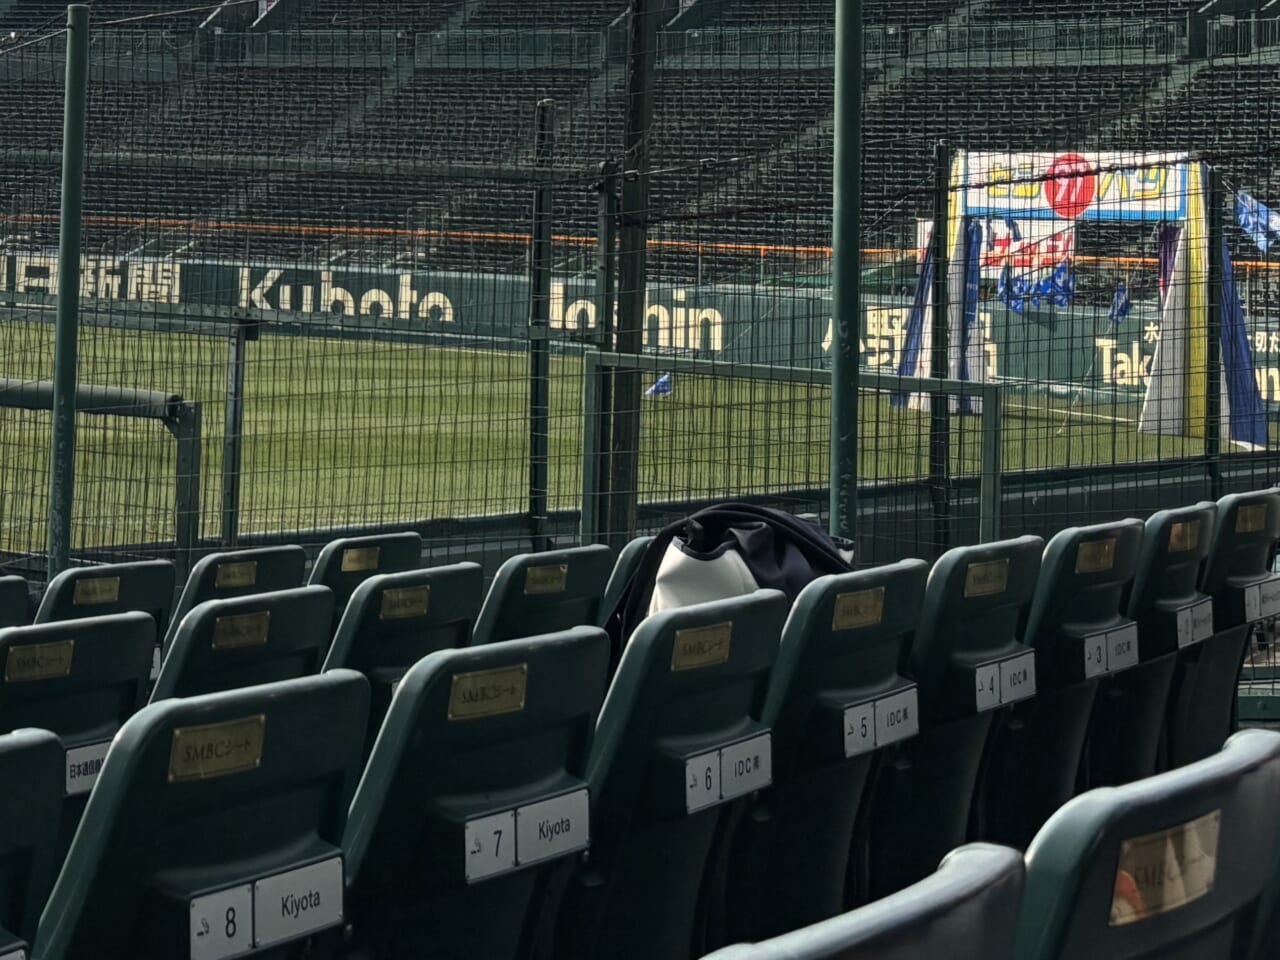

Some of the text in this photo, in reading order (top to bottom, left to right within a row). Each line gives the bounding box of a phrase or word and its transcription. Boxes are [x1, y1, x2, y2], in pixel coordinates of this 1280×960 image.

[860, 716, 868, 738] 5
[705, 766, 712, 791] 6
[493, 817, 571, 857] 7 Kiyota
[225, 890, 321, 938] 8 Kiyota
